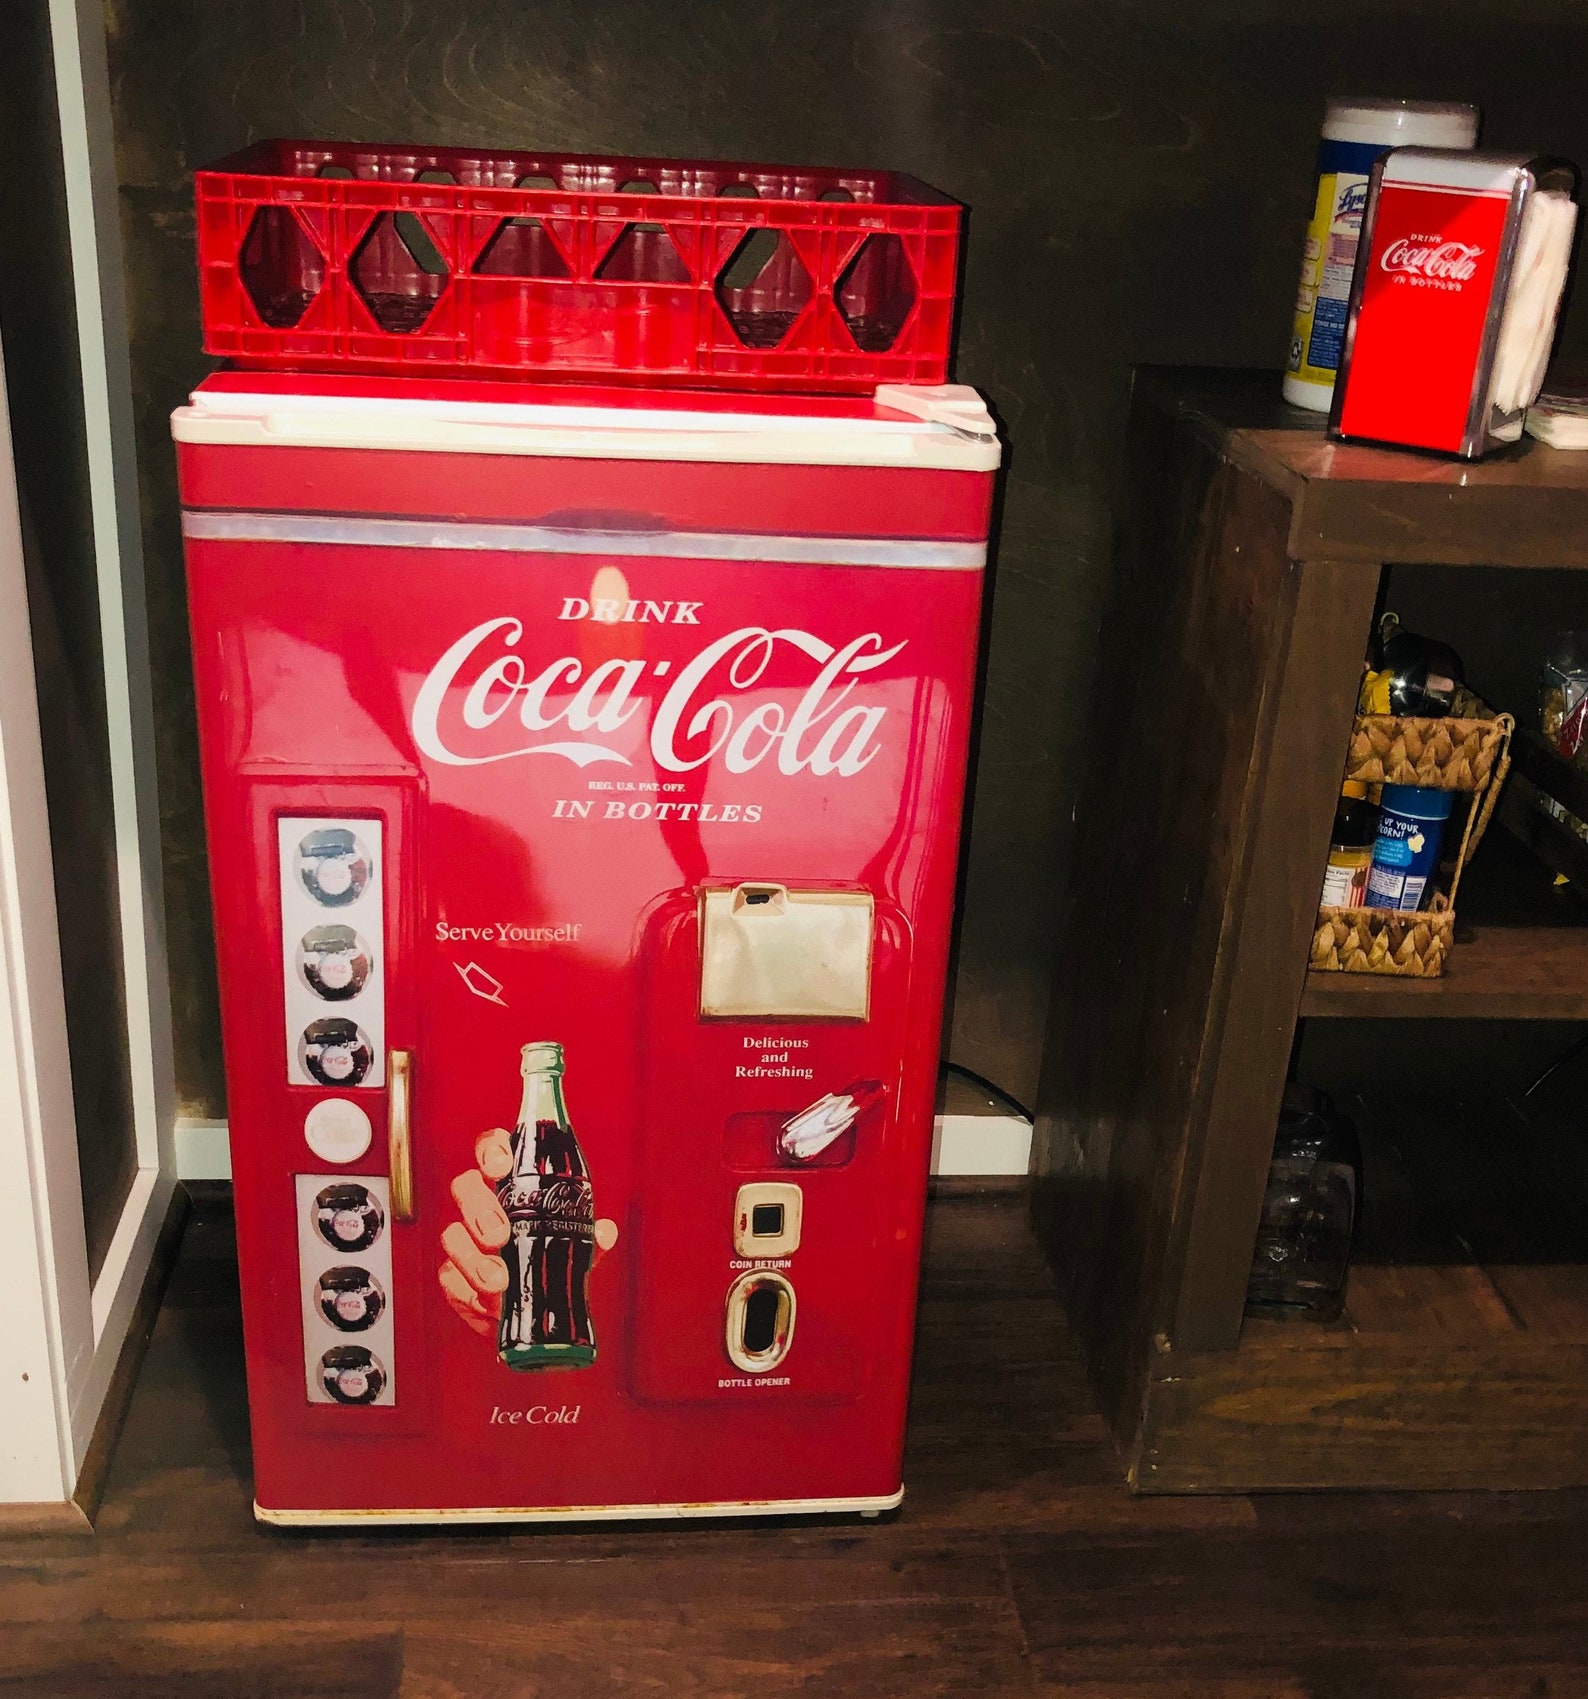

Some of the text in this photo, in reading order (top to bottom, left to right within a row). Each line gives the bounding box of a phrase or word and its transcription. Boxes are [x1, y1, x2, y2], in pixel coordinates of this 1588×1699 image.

[1338, 183, 1367, 212] Lys
[1410, 233, 1443, 244] DRINK
[1392, 274, 1406, 285] IN
[1409, 276, 1463, 292] BOTTLES
[558, 597, 704, 625] DRINK
[412, 616, 909, 777] Coca-Cola
[588, 781, 614, 791] REG.
[616, 781, 636, 791] U.S.
[662, 783, 686, 793] OFF.
[552, 799, 763, 823] IN BOTTLES
[1384, 817, 1394, 827] UP
[1396, 820, 1419, 834] YOUR
[435, 921, 583, 942] Serve Yourself
[743, 1036, 810, 1050] Delicious
[760, 1052, 789, 1064] and
[735, 1065, 814, 1080] Refreshing
[729, 1259, 792, 1269] COIN RETURN
[718, 1377, 791, 1388] BOTTLE OPENER
[489, 1405, 581, 1424] Ice Cold
